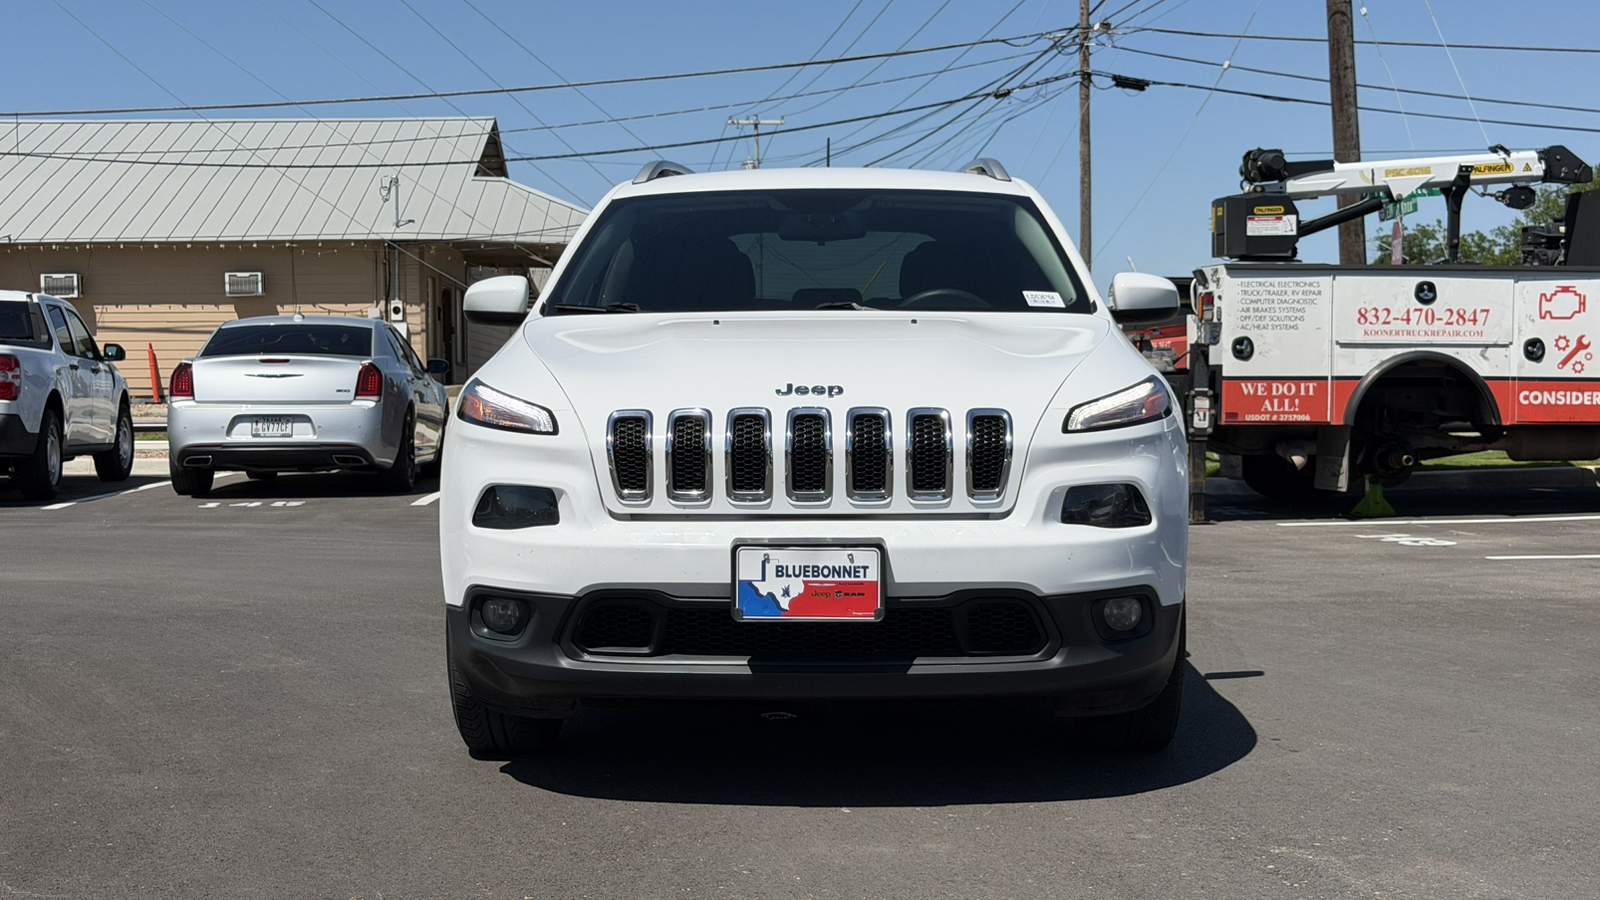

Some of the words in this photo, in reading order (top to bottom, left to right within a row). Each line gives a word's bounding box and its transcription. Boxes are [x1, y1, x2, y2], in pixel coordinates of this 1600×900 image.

[1357, 307, 1490, 326] 832-470-2847
[1363, 329, 1484, 338] KOONERTRUCKREPAIR.COM
[775, 383, 844, 398] Jeep
[1240, 382, 1268, 396] WE
[1271, 382, 1297, 396] DO
[1300, 382, 1317, 396] IT
[1261, 398, 1300, 412] ALL!
[1519, 391, 1600, 405] CONSIDER
[261, 422, 289, 432] GV77CF
[775, 565, 870, 579] BLUEBONNET
[811, 590, 832, 599] Jeep
